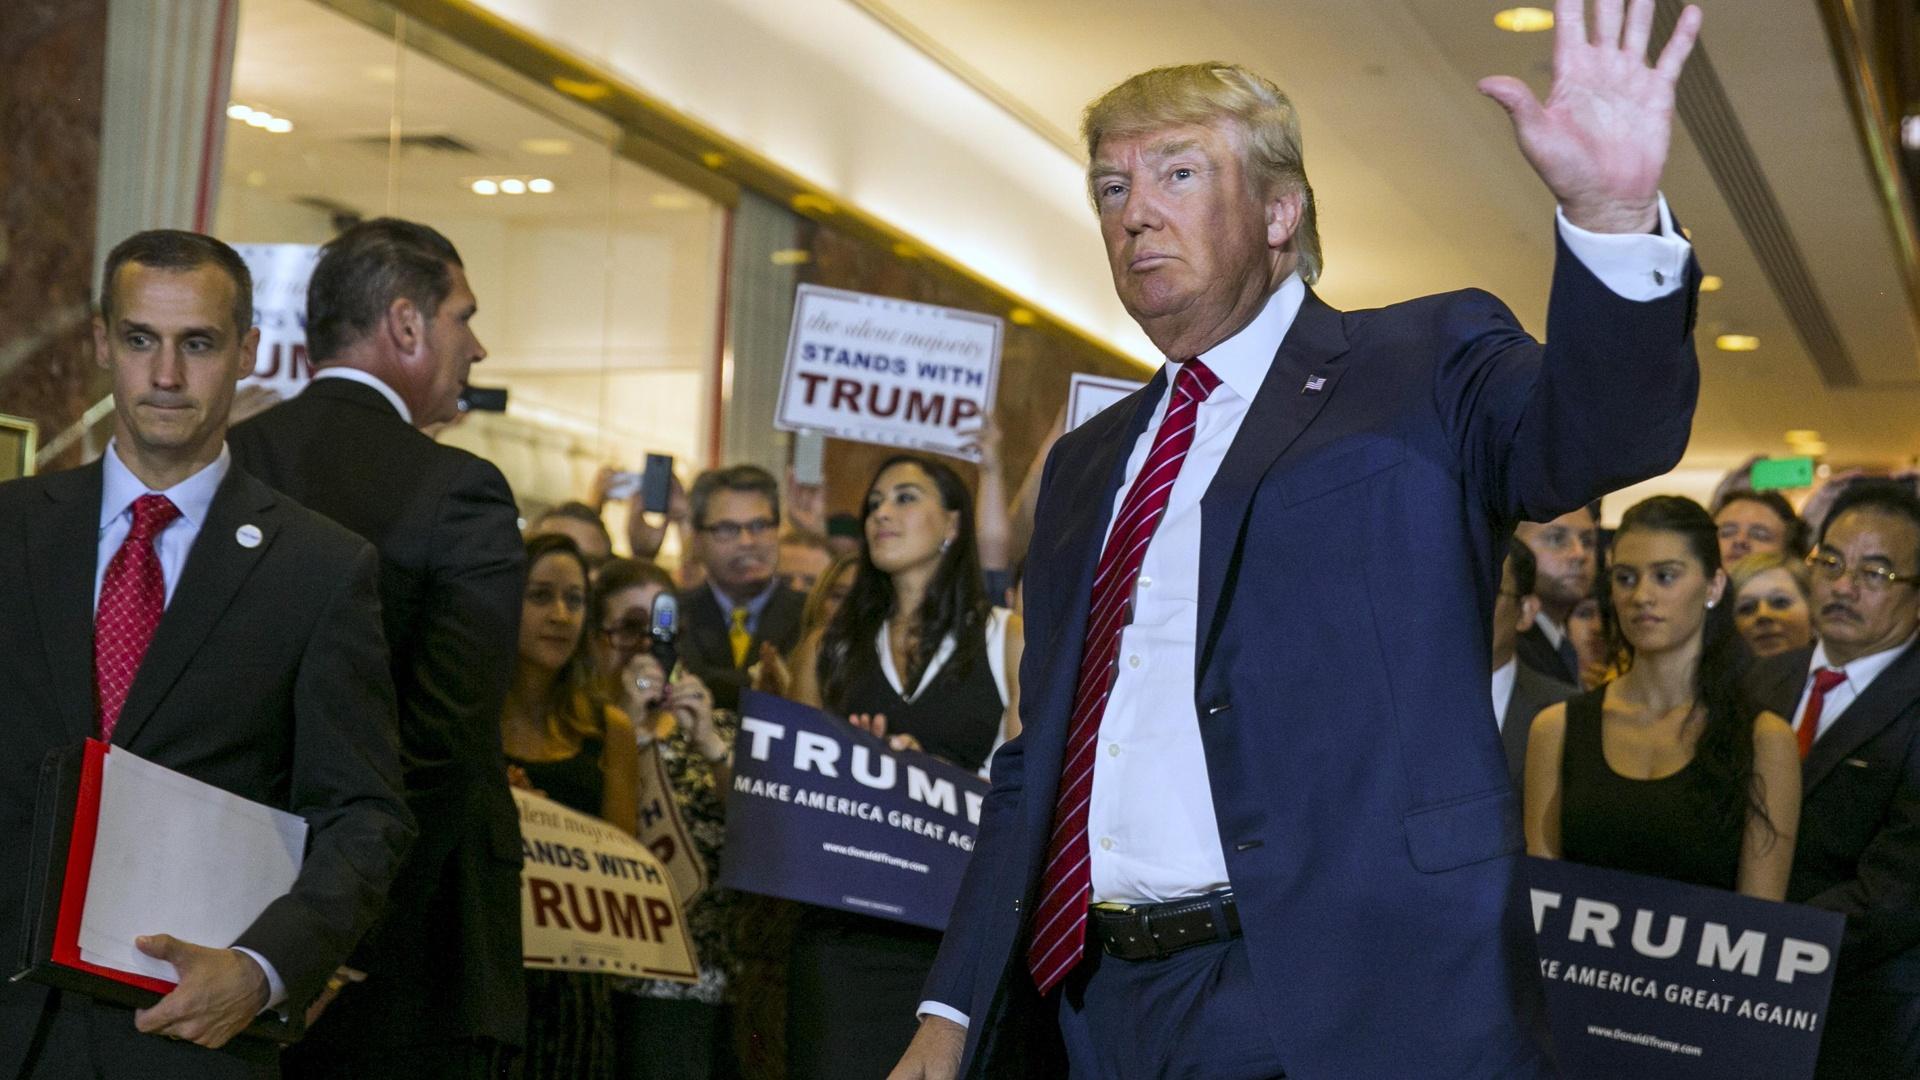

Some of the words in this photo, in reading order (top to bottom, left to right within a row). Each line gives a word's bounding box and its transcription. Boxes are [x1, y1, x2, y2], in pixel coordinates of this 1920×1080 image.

[801, 342, 907, 376] STANDS
[917, 360, 984, 387] WITH
[806, 310, 839, 335] the
[844, 319, 898, 342] silent
[899, 331, 984, 360] majority
[797, 372, 979, 429] TRUMP
[734, 774, 792, 803] MAKE
[793, 788, 884, 824] AMERICA
[888, 810, 946, 842] GREAT
[522, 836, 591, 873] ANDS
[594, 852, 663, 885] WITH
[528, 877, 674, 944] RUMP
[1530, 888, 1831, 985] TRUMP
[1563, 963, 1658, 999] AMERICA
[1664, 983, 1735, 1015] GREAT
[1737, 999, 1819, 1033] AGAIN!
